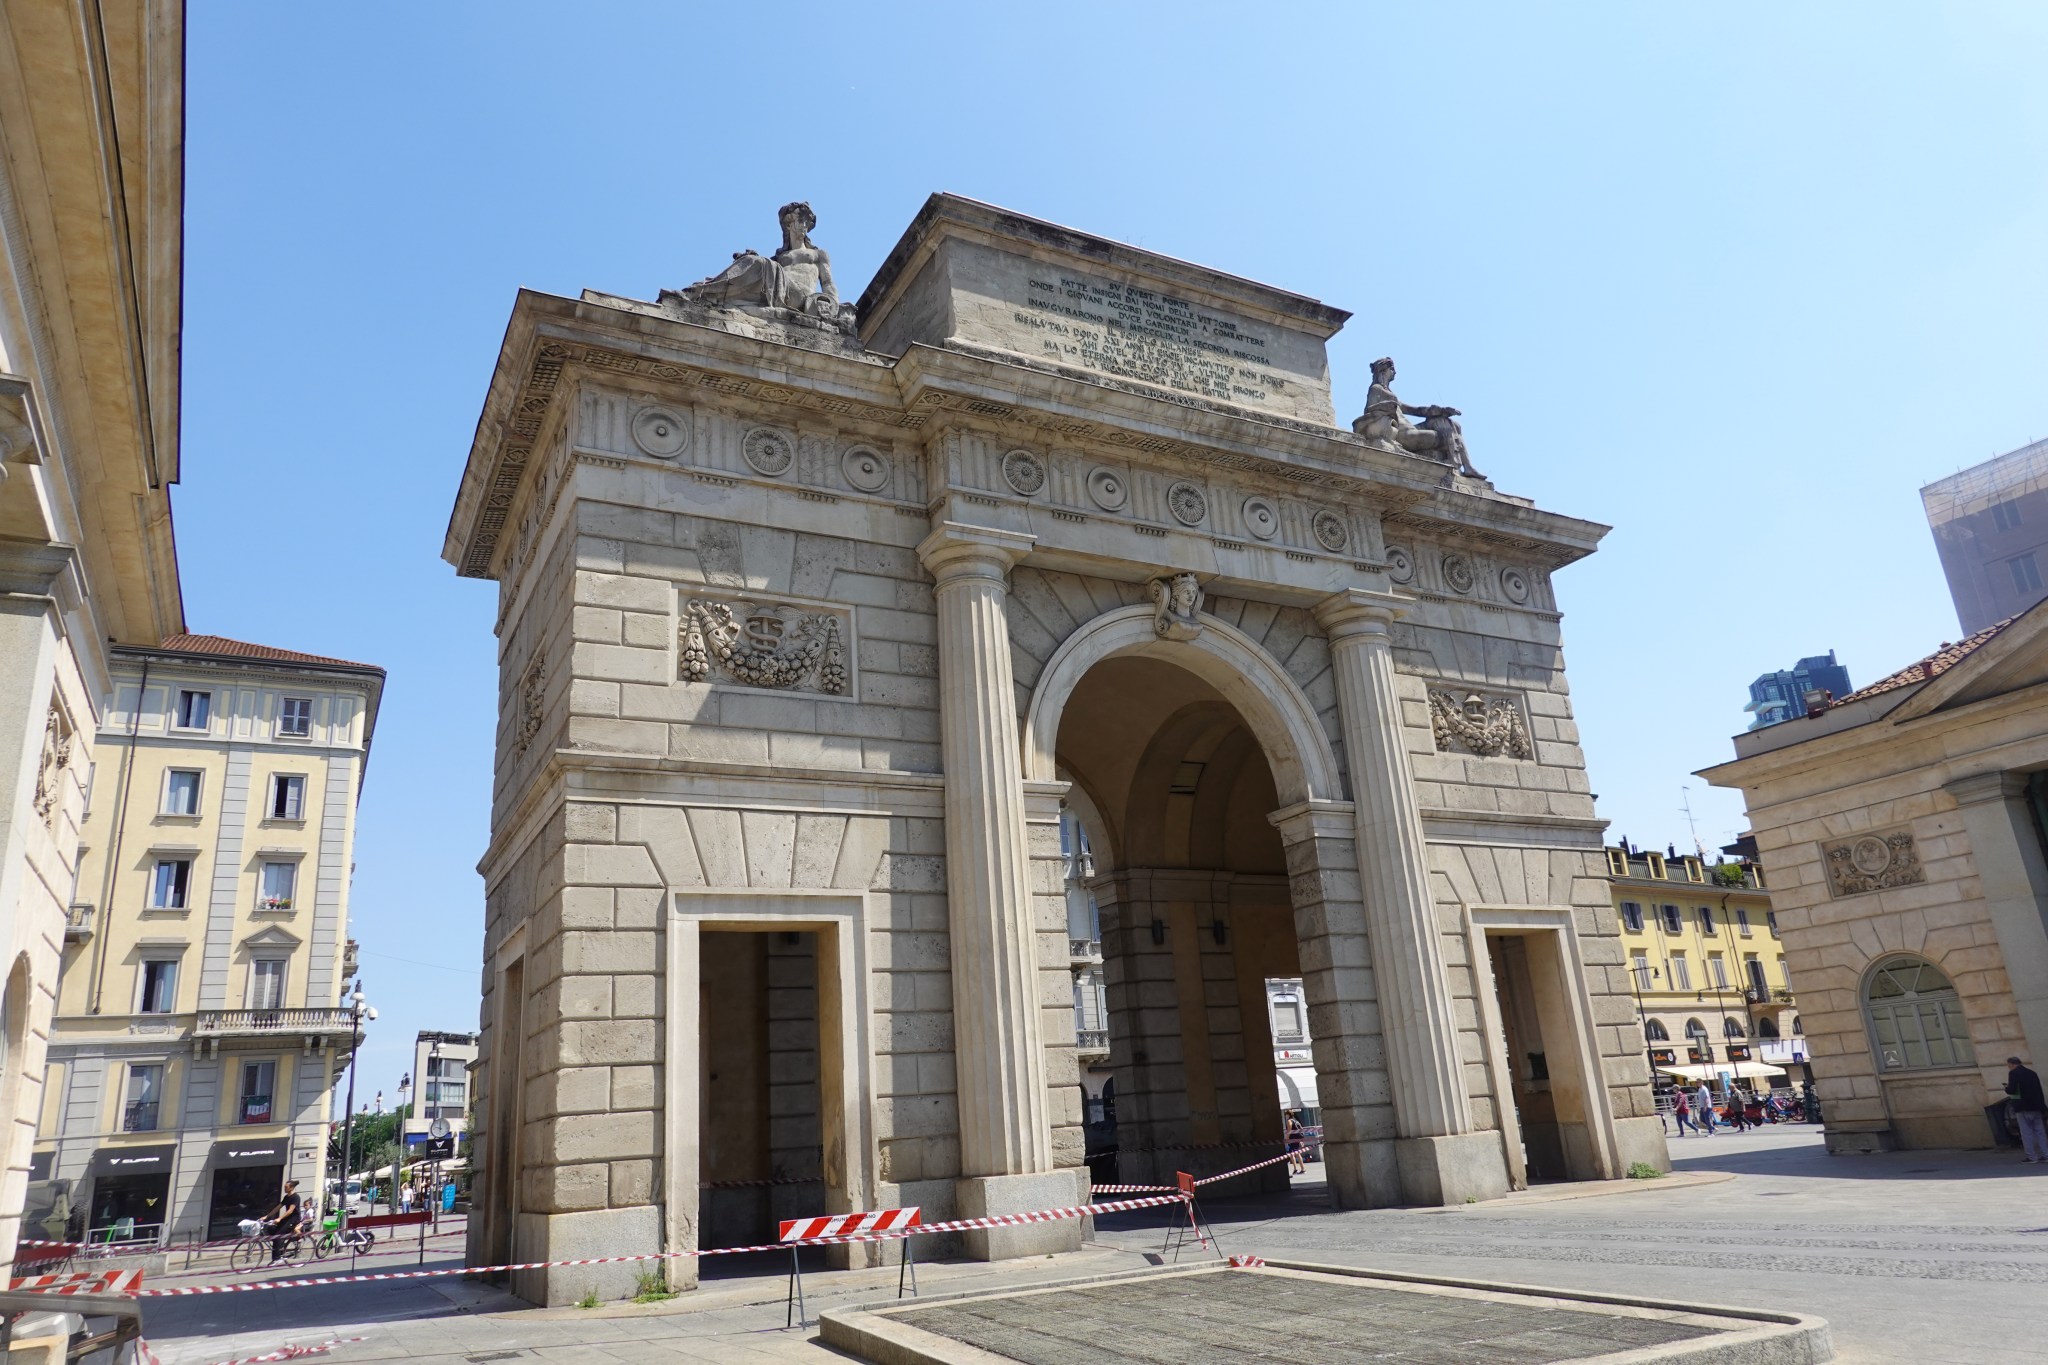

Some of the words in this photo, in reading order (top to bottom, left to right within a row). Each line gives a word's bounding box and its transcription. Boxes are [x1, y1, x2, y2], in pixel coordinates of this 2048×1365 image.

[1060, 278, 1088, 292] FATTE
[1092, 286, 1122, 300] INSIGNI
[1125, 296, 1139, 306] DAI
[1142, 300, 1165, 312] NOMI
[1168, 308, 1194, 320] DELLE
[1197, 314, 1237, 332] VITTORIE
[1109, 283, 1121, 292] SV
[1162, 296, 1190, 310] PORTE
[1029, 280, 1054, 292] ONDE
[1066, 290, 1102, 305] GIOVANI
[1108, 300, 1142, 316] ACCORSI
[1146, 310, 1197, 330] VOLONTARII
[1213, 328, 1265, 348] COMBATTERE
[1118, 312, 1142, 324] DVCE
[1146, 319, 1189, 336] GARIBALDI
[1028, 298, 1104, 323] INAVGVRARONO
[1108, 318, 1125, 329] NEL
[1130, 323, 1174, 340] MDCCCLIX
[1178, 336, 1190, 345] LA
[1193, 340, 1230, 355] SECONDA
[1234, 350, 1270, 366] RISCOSSA
[1106, 327, 1116, 336] IL
[1083, 358, 1096, 369] LA
[1102, 344, 1128, 357] QVEL
[1104, 336, 1120, 346] XXI
[1239, 369, 1257, 380] NON
[1064, 344, 1078, 354] LO
[1082, 349, 1118, 364] ETERNA
[1192, 375, 1210, 386] CHE
[1214, 380, 1230, 392] NEL
[122, 1156, 160, 1164] CUPRA
